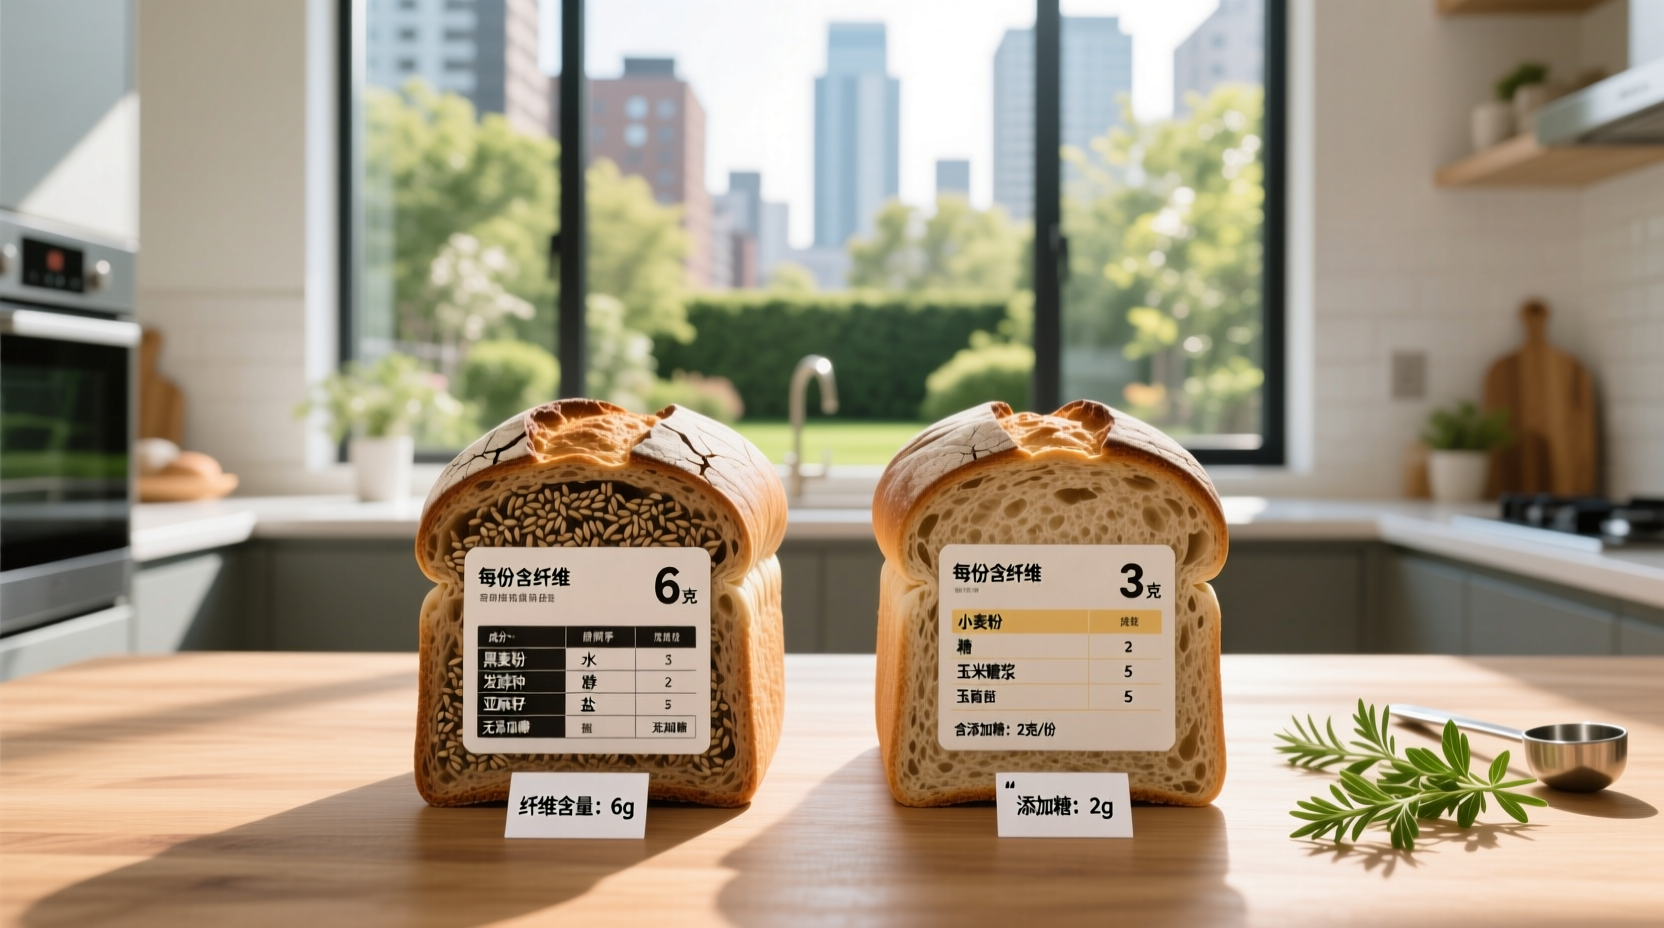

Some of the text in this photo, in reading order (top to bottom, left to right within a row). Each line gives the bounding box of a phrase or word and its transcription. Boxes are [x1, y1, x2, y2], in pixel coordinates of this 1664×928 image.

[478, 567, 571, 587] 每份含纤维
[953, 563, 1042, 583] 每份含纤维
[958, 613, 1003, 631] 小麦粉
[1124, 641, 1133, 653] 2
[581, 652, 597, 667] 水
[664, 654, 672, 665] 3
[1124, 665, 1133, 678] 5
[664, 677, 672, 688] 2
[1124, 690, 1133, 703] 5
[580, 696, 596, 712] 盐
[664, 699, 672, 710] 5
